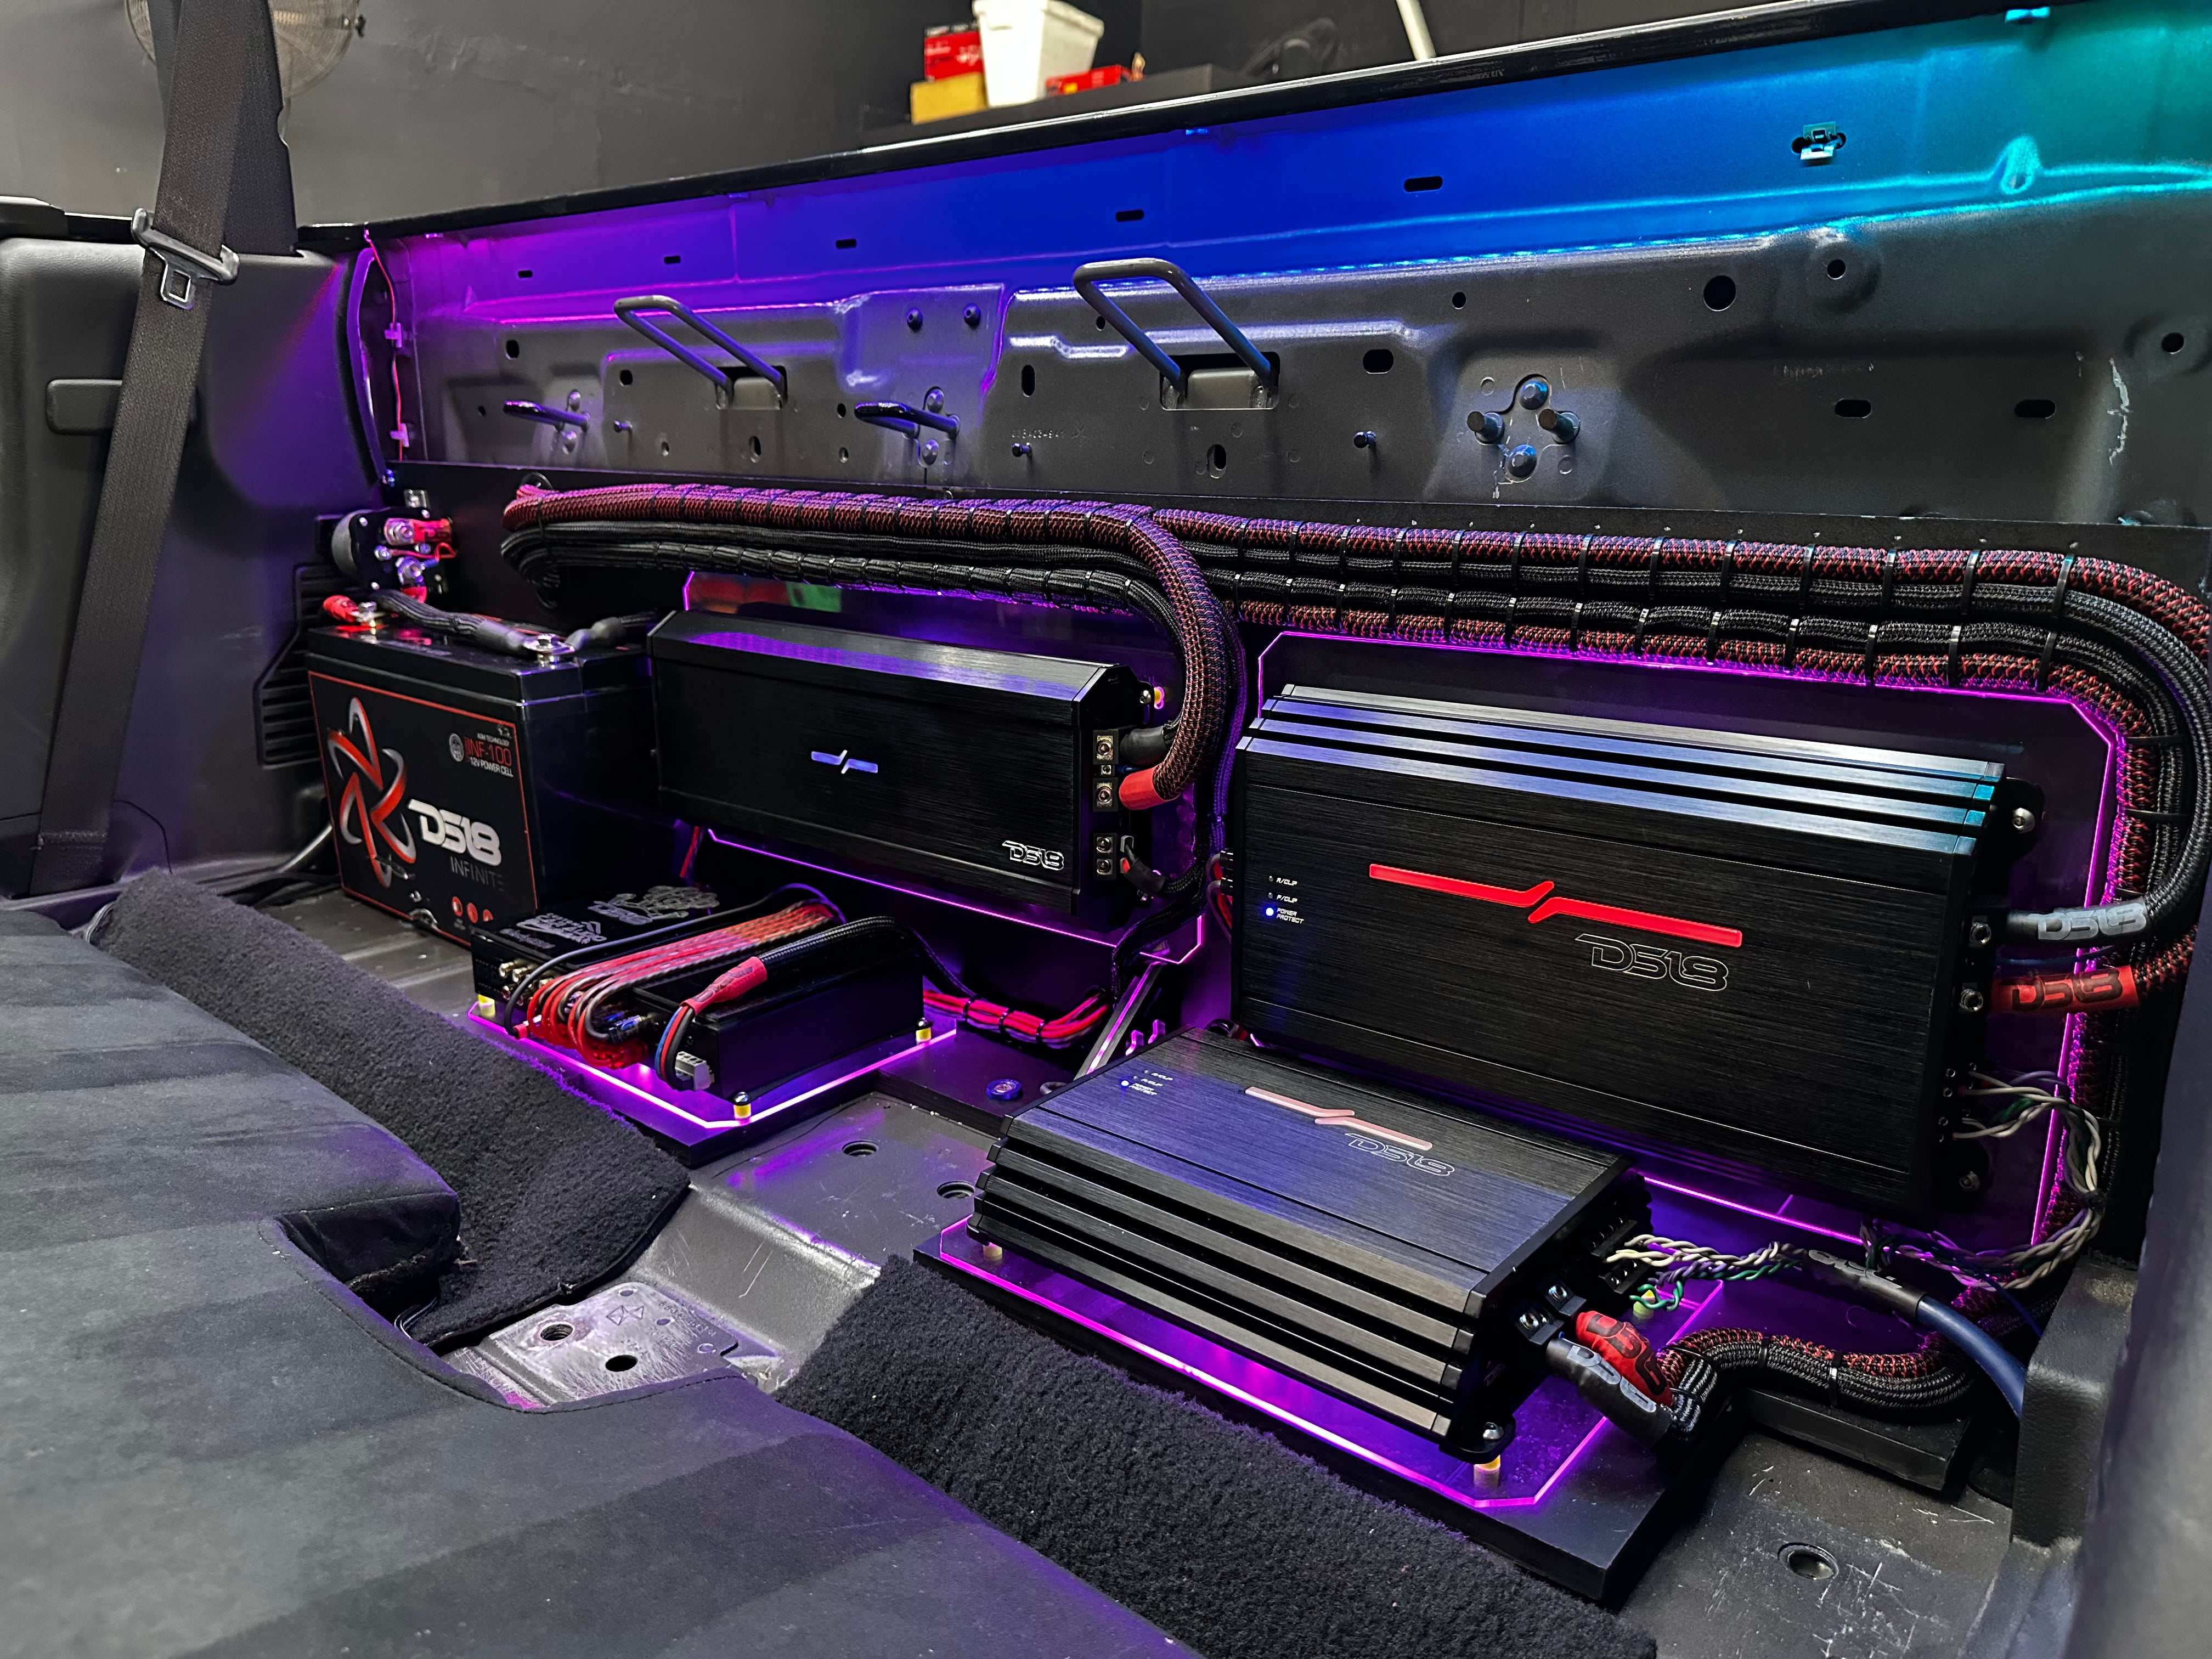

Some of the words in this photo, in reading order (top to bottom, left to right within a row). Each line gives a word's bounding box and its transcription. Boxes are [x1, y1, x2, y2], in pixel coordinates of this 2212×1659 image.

[481, 759, 500, 773] POWER
[408, 798, 502, 866] DS18
[1002, 840, 1064, 871] DS18
[1276, 907, 1297, 917] POWER
[1276, 913, 1305, 924] PROTECT
[2029, 902, 2147, 940] DS18
[1574, 933, 1730, 992] DS18
[1997, 969, 2123, 1011] DS18
[1345, 1132, 1455, 1177] DS18
